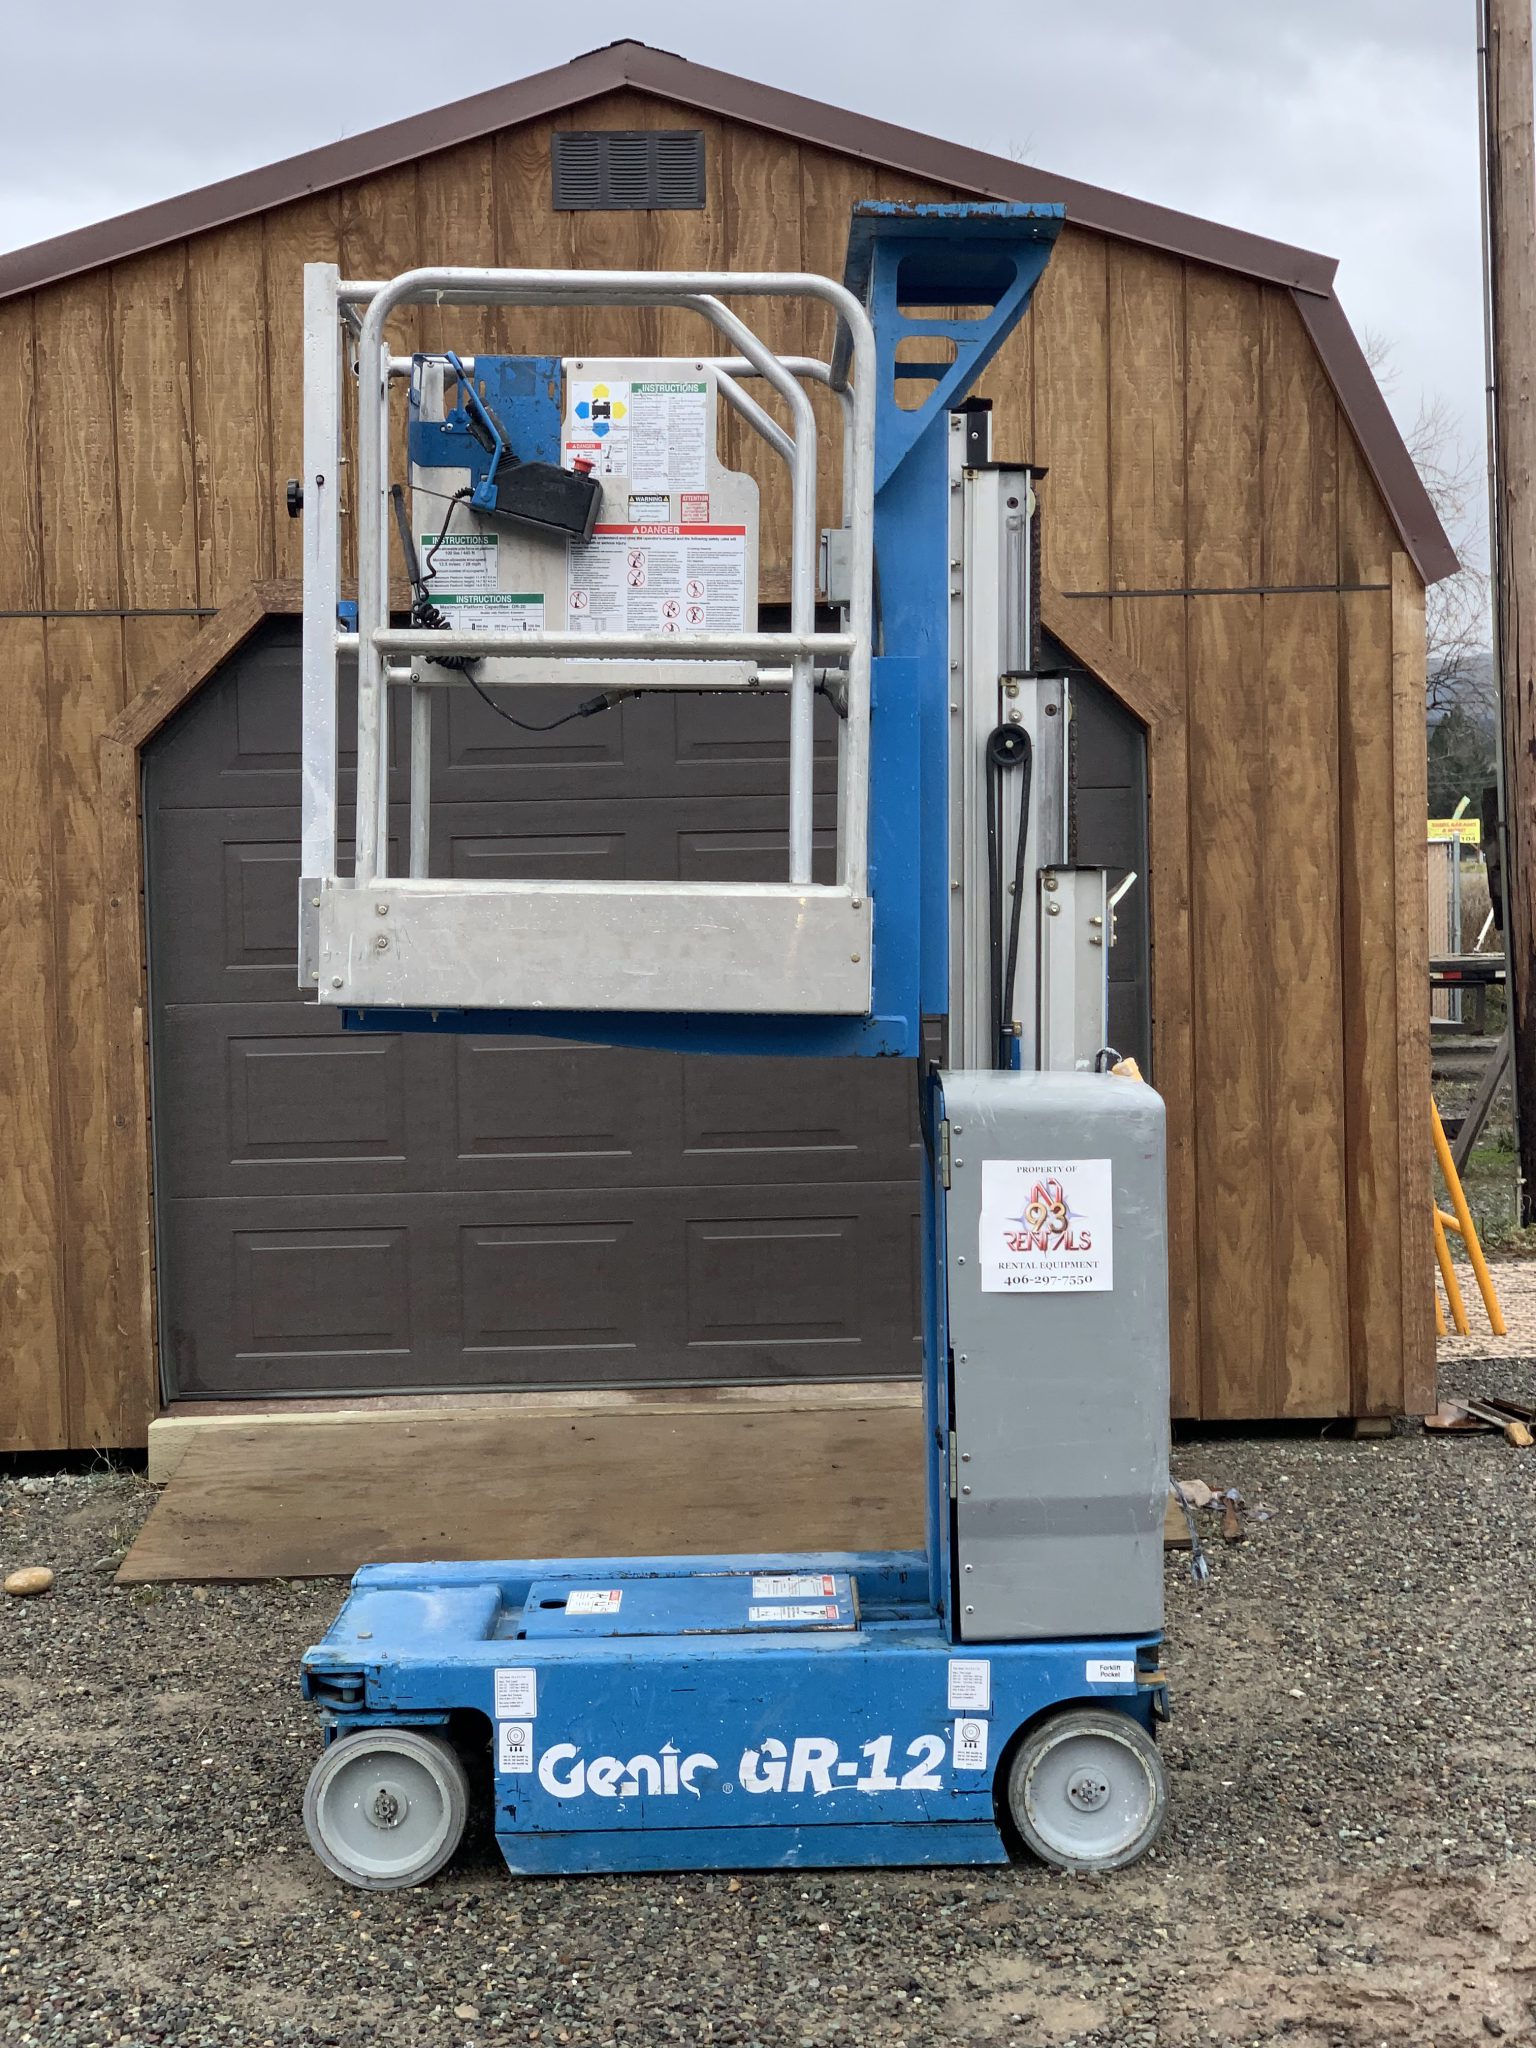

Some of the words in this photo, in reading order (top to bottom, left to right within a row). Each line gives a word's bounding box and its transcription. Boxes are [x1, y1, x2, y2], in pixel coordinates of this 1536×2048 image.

[642, 383, 699, 392] INSTRUCTIONS
[640, 526, 680, 535] DANGER
[456, 595, 512, 603] INSTRUCTIONS
[1016, 1166, 1063, 1174] PROPERTY
[1065, 1165, 1078, 1173] OF
[1025, 1202, 1069, 1234] 93
[1003, 1230, 1092, 1253] RENTALS
[998, 1261, 1038, 1270] RENTAL
[1040, 1261, 1100, 1270] EQUIPMENT
[1003, 1275, 1093, 1286] 406-297-7550
[739, 1734, 946, 1794] GR-12
